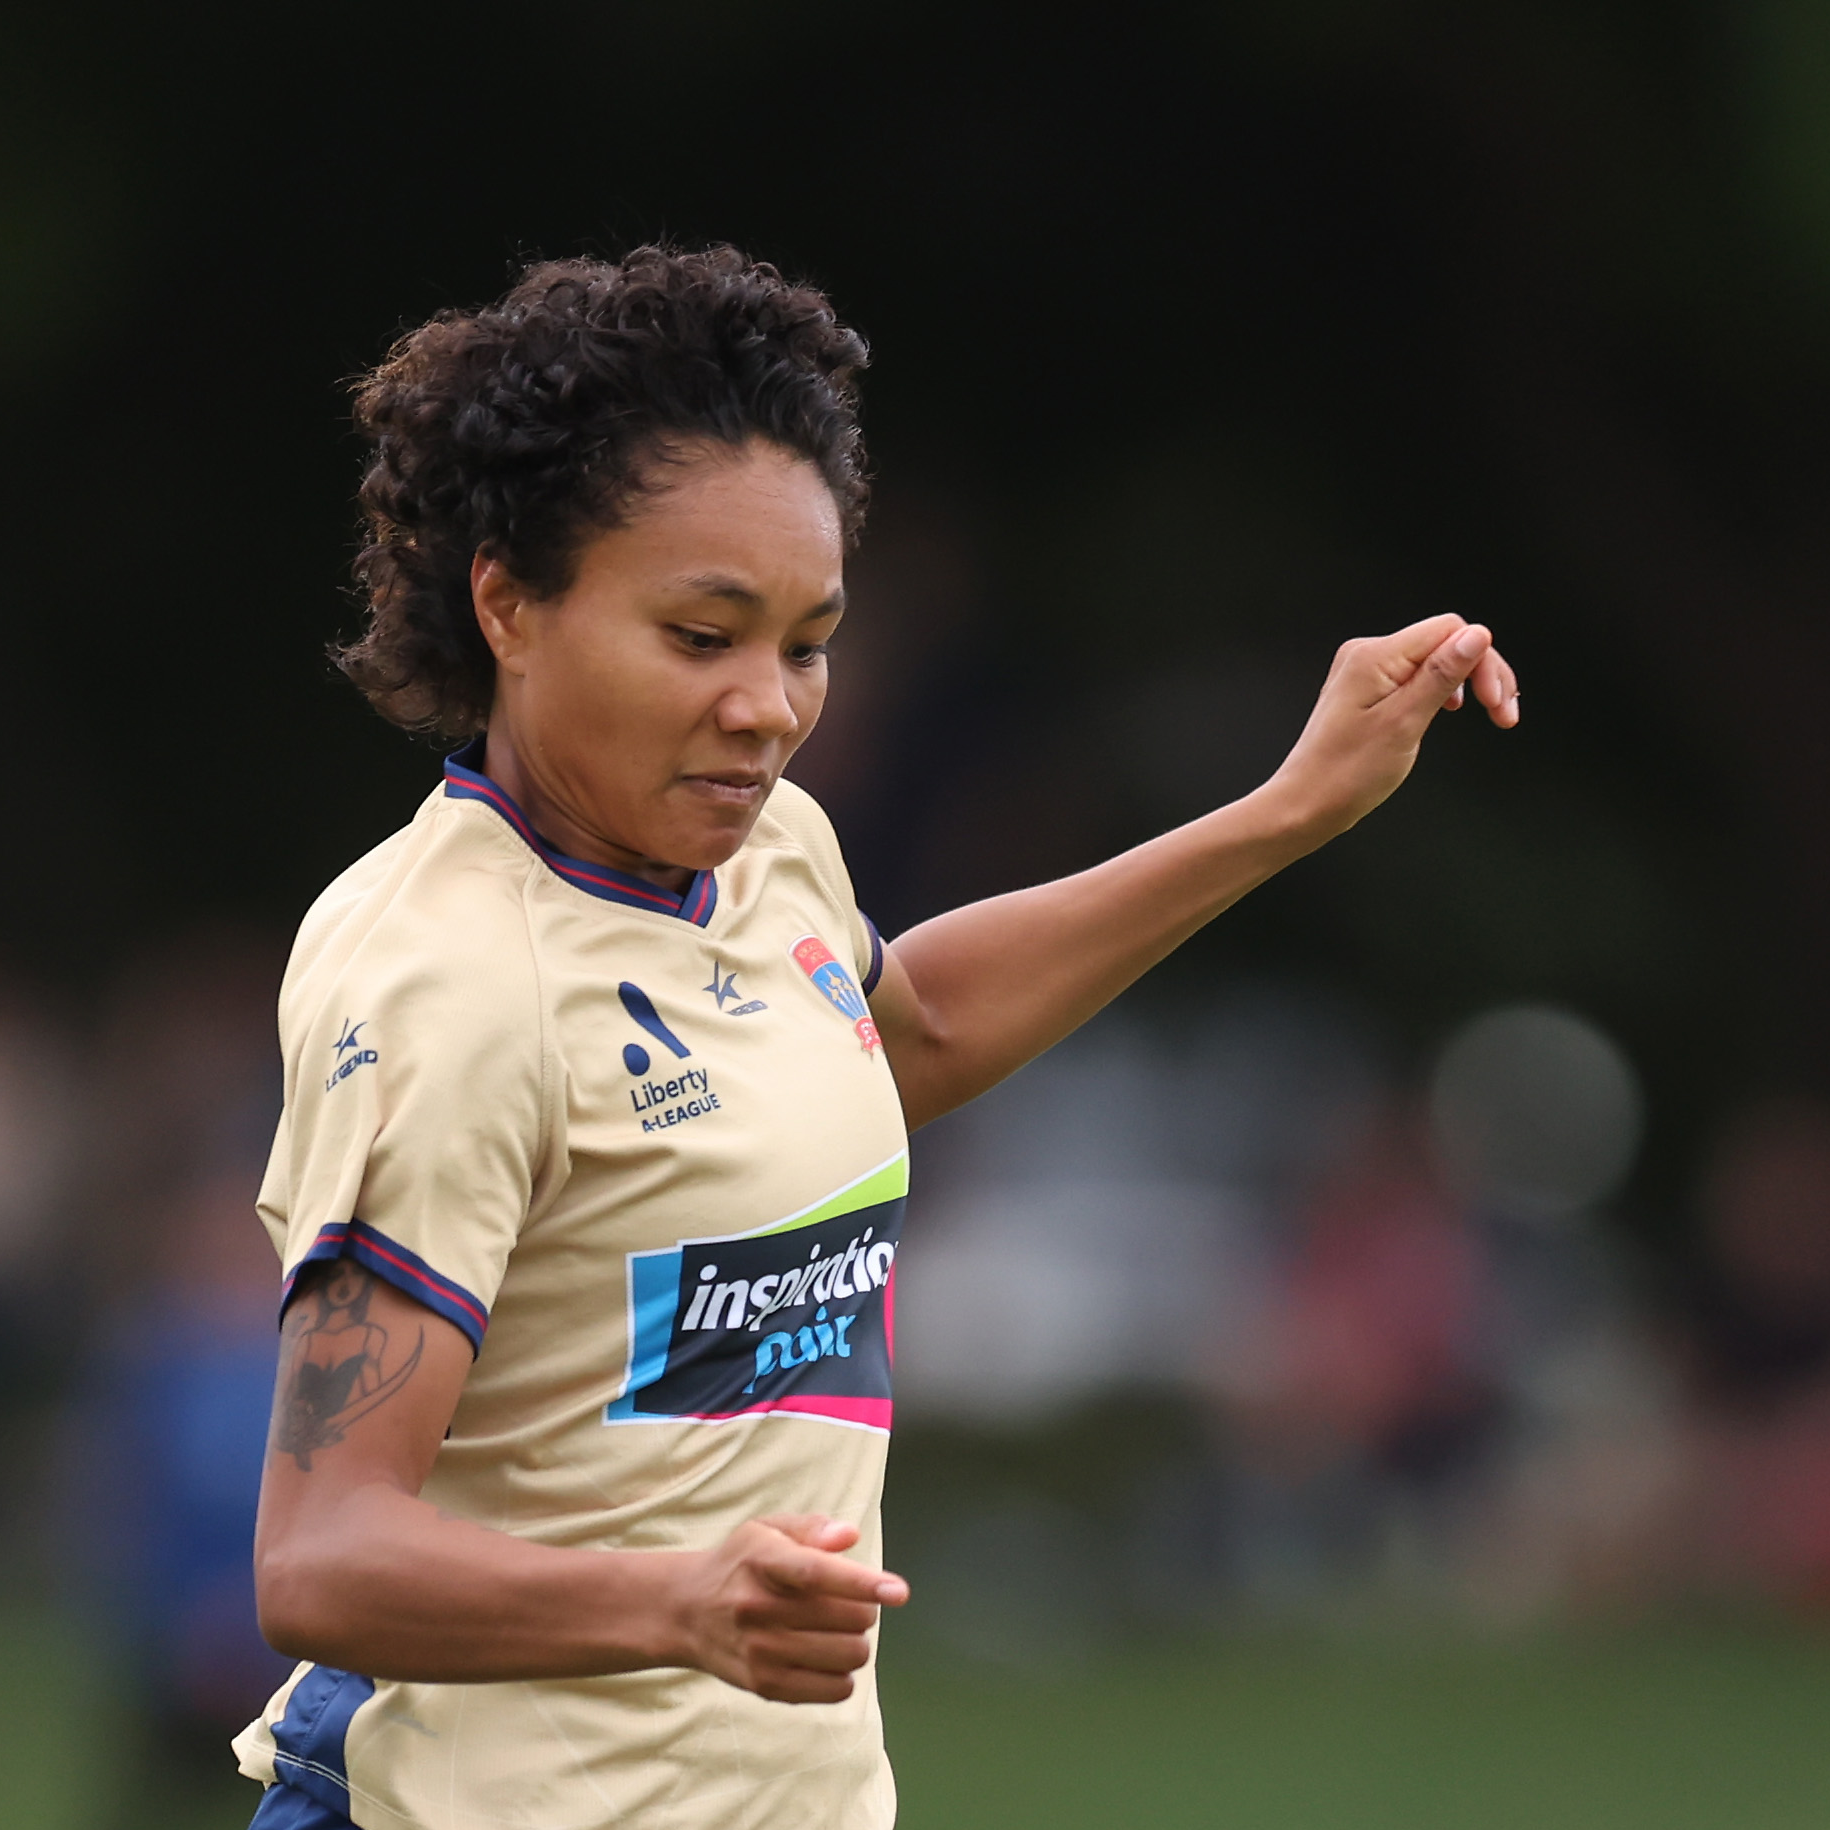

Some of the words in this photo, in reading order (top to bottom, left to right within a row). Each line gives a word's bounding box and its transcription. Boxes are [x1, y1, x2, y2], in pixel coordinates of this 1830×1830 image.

[631, 1069, 707, 1113] Liberty
[641, 1094, 721, 1133] A-LEAGUE
[681, 1227, 899, 1332] inspiratio
